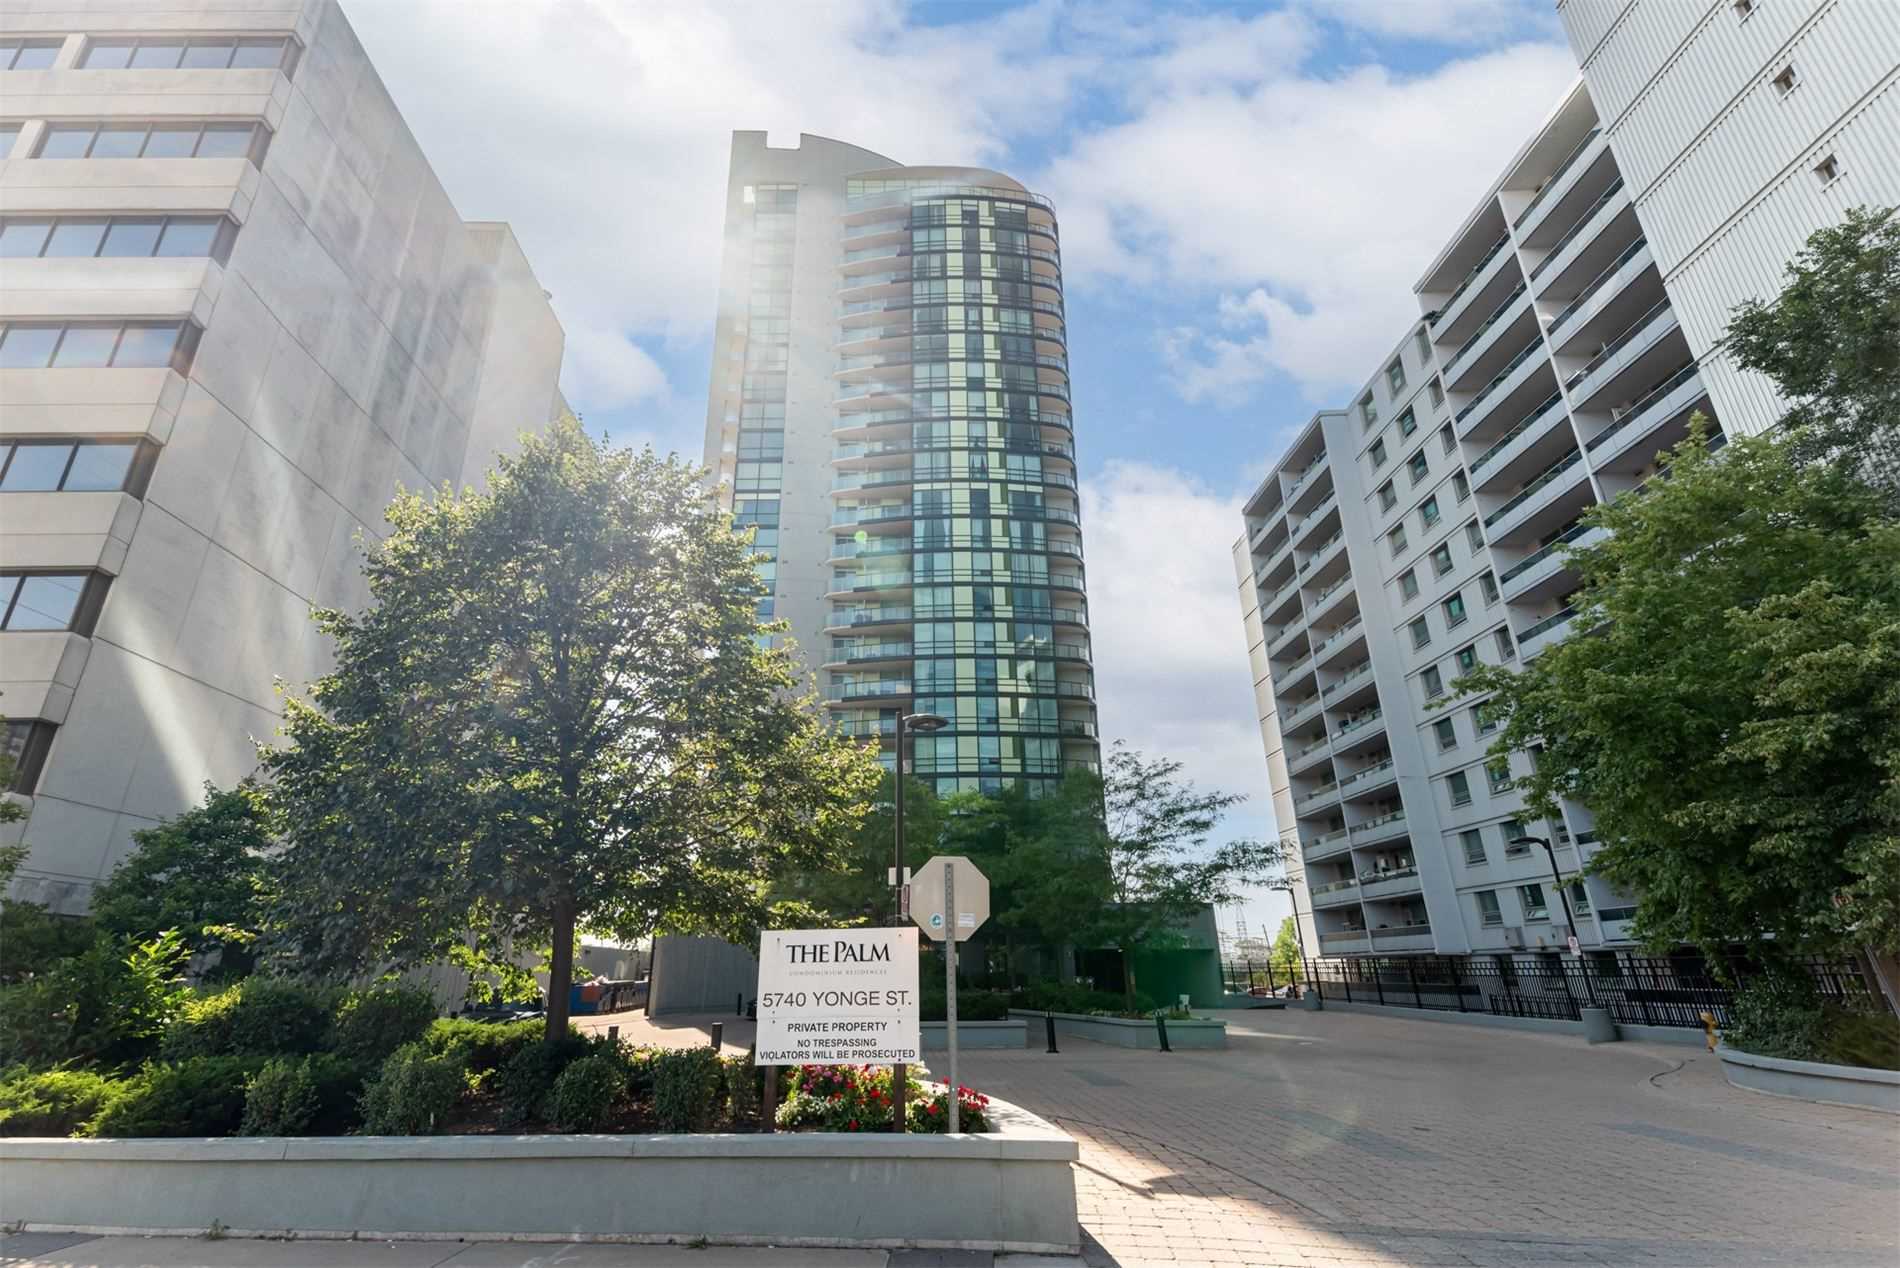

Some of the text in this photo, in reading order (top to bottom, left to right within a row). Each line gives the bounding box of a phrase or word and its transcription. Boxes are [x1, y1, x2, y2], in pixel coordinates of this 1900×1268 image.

[786, 943, 830, 964] THE
[762, 989, 912, 1008] 5740 YONGE ST.
[787, 1021, 888, 1033] PRIVATE PROPERTY
[797, 1038, 877, 1048] NO TRESPASSING
[760, 1048, 915, 1060] VIOLATORS WILL BE PROSECUTED
